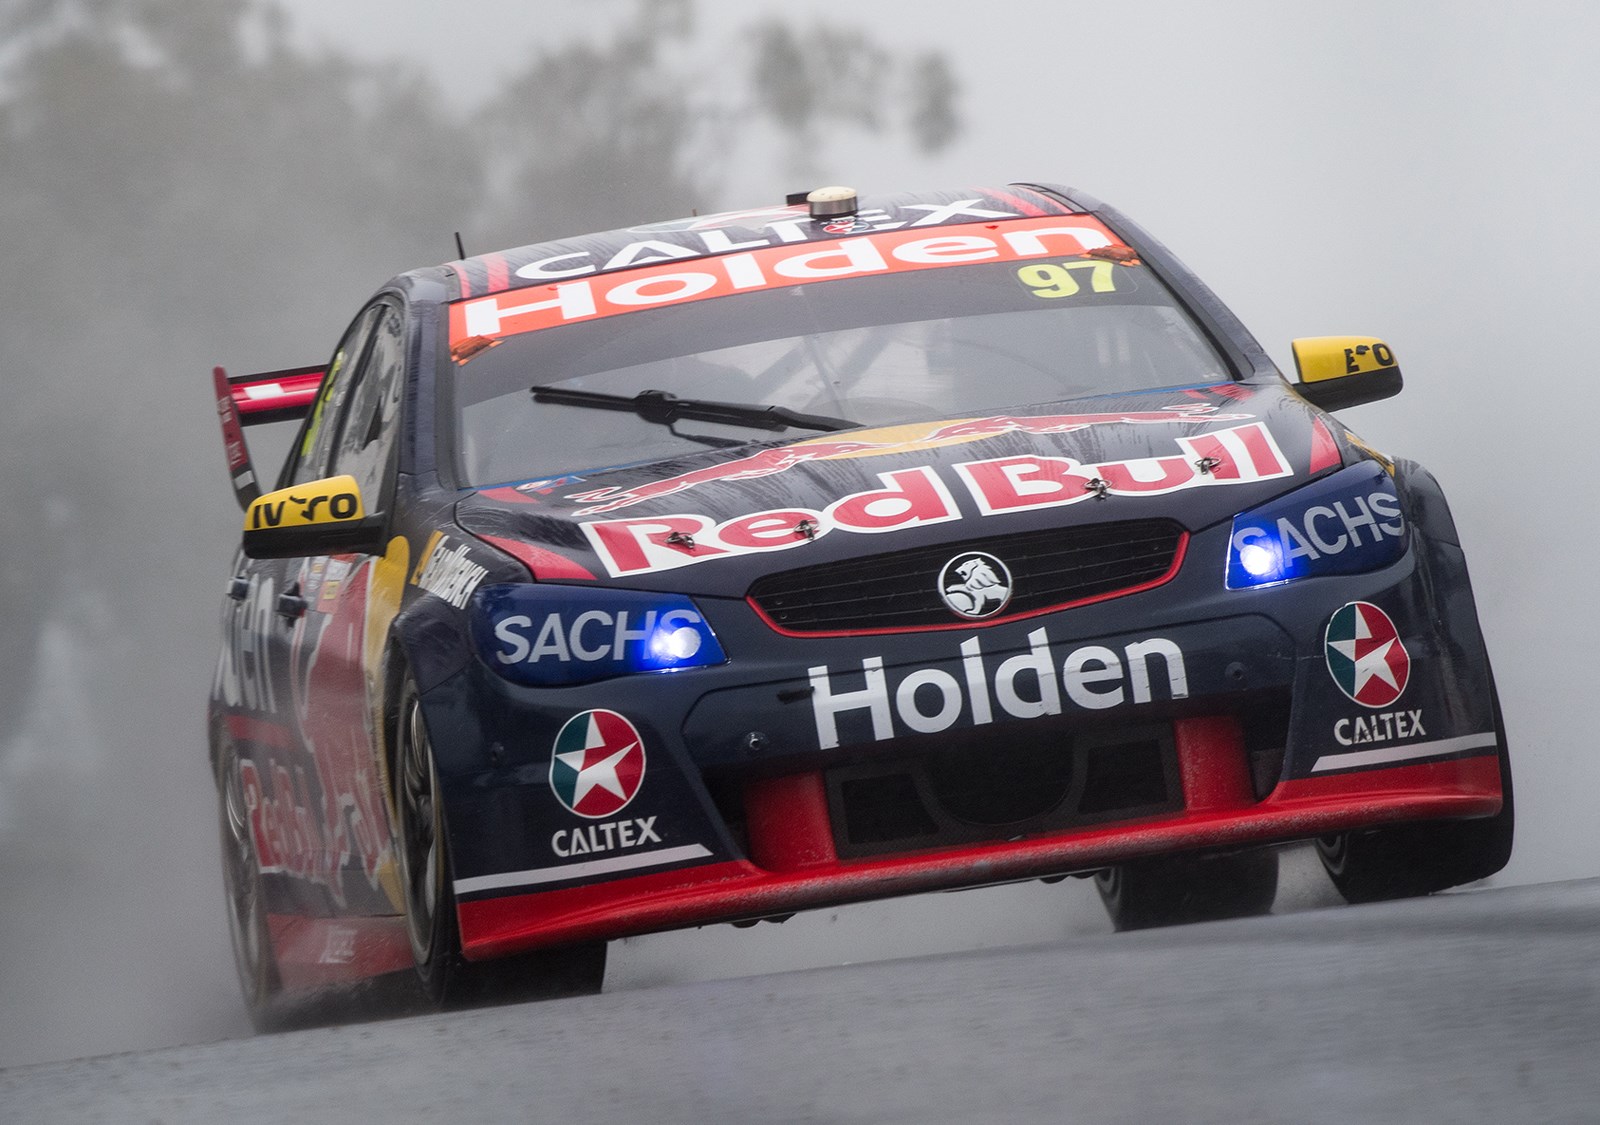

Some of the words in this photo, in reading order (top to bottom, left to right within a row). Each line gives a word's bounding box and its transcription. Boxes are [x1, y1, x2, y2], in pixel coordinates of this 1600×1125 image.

[464, 226, 1113, 337] Holden
[1017, 260, 1116, 299] 97
[579, 465, 962, 578] Red
[952, 421, 1294, 517] Bull
[1233, 492, 1405, 575] SACHS
[494, 609, 701, 665] SACHS
[807, 627, 1189, 750] Holden
[1333, 708, 1427, 746] CALTEX
[551, 816, 662, 857] CALTEX
